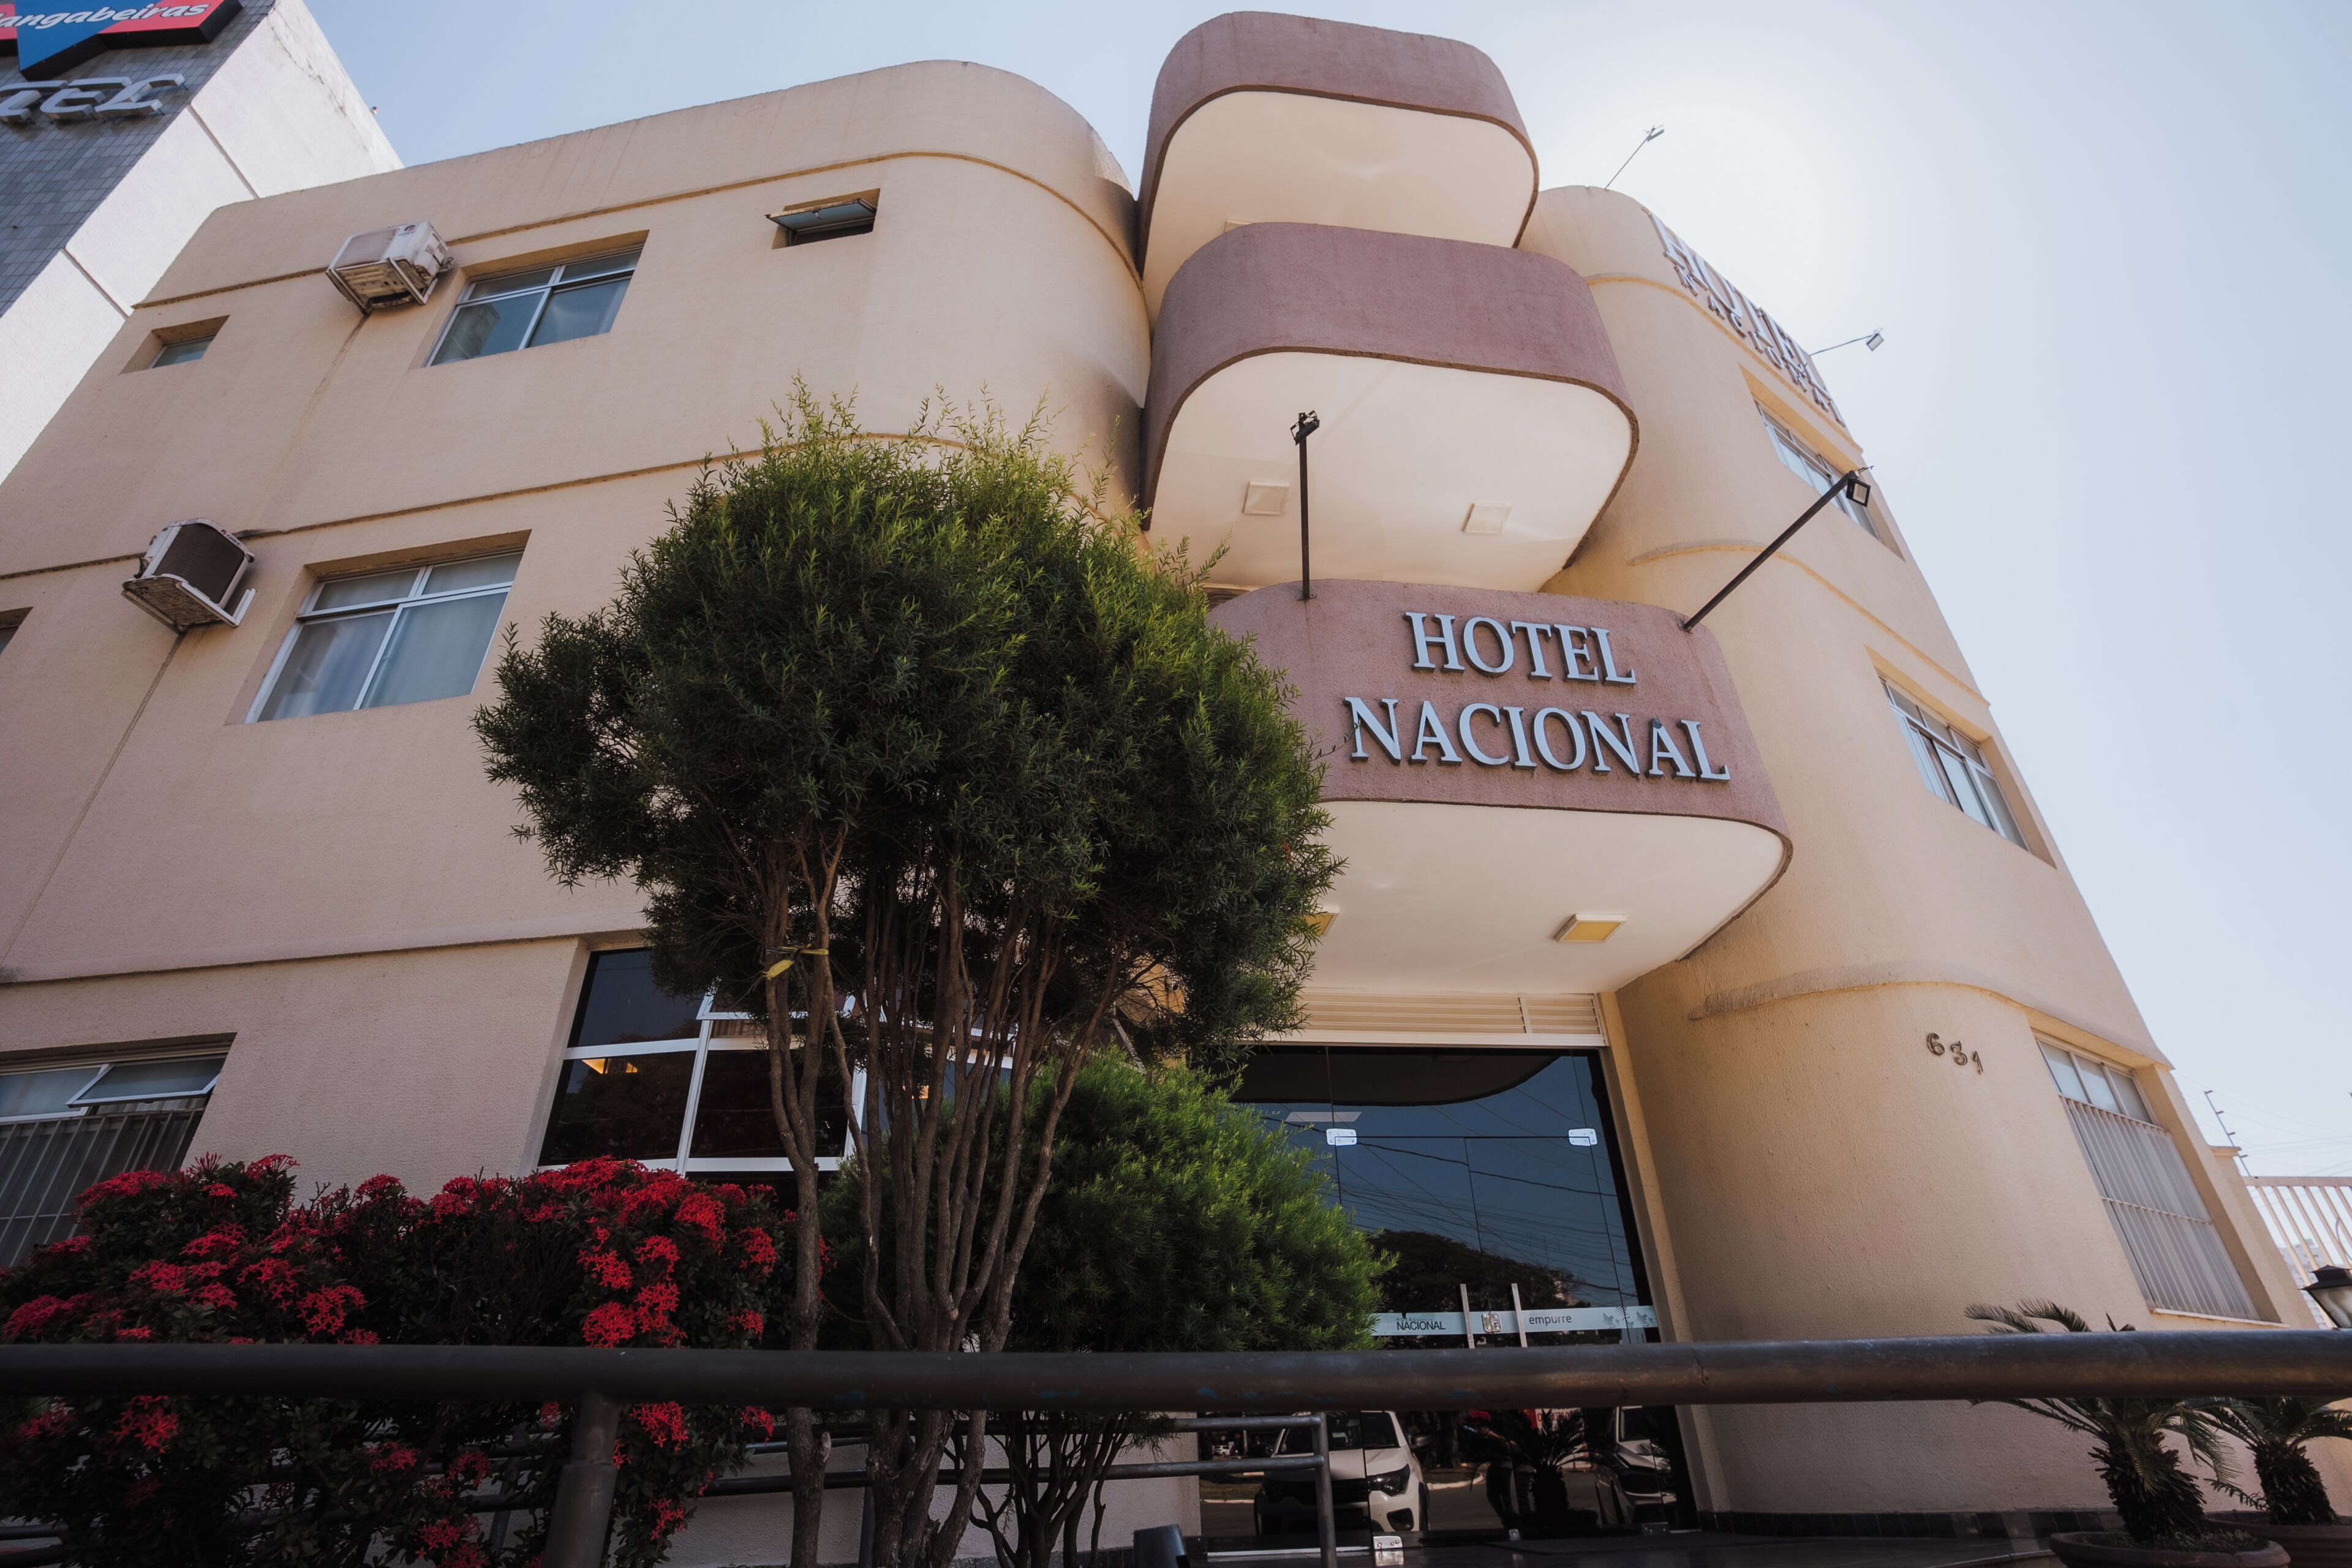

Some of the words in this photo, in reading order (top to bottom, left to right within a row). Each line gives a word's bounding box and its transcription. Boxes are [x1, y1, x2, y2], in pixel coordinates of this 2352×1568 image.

[0, 4, 209, 30] angabeiras
[1405, 612, 1637, 686] HOTEL
[1344, 696, 1731, 783] NACIONAL
[1396, 1321, 1446, 1330] NACIONAL
[1529, 1316, 1572, 1326] empurre
